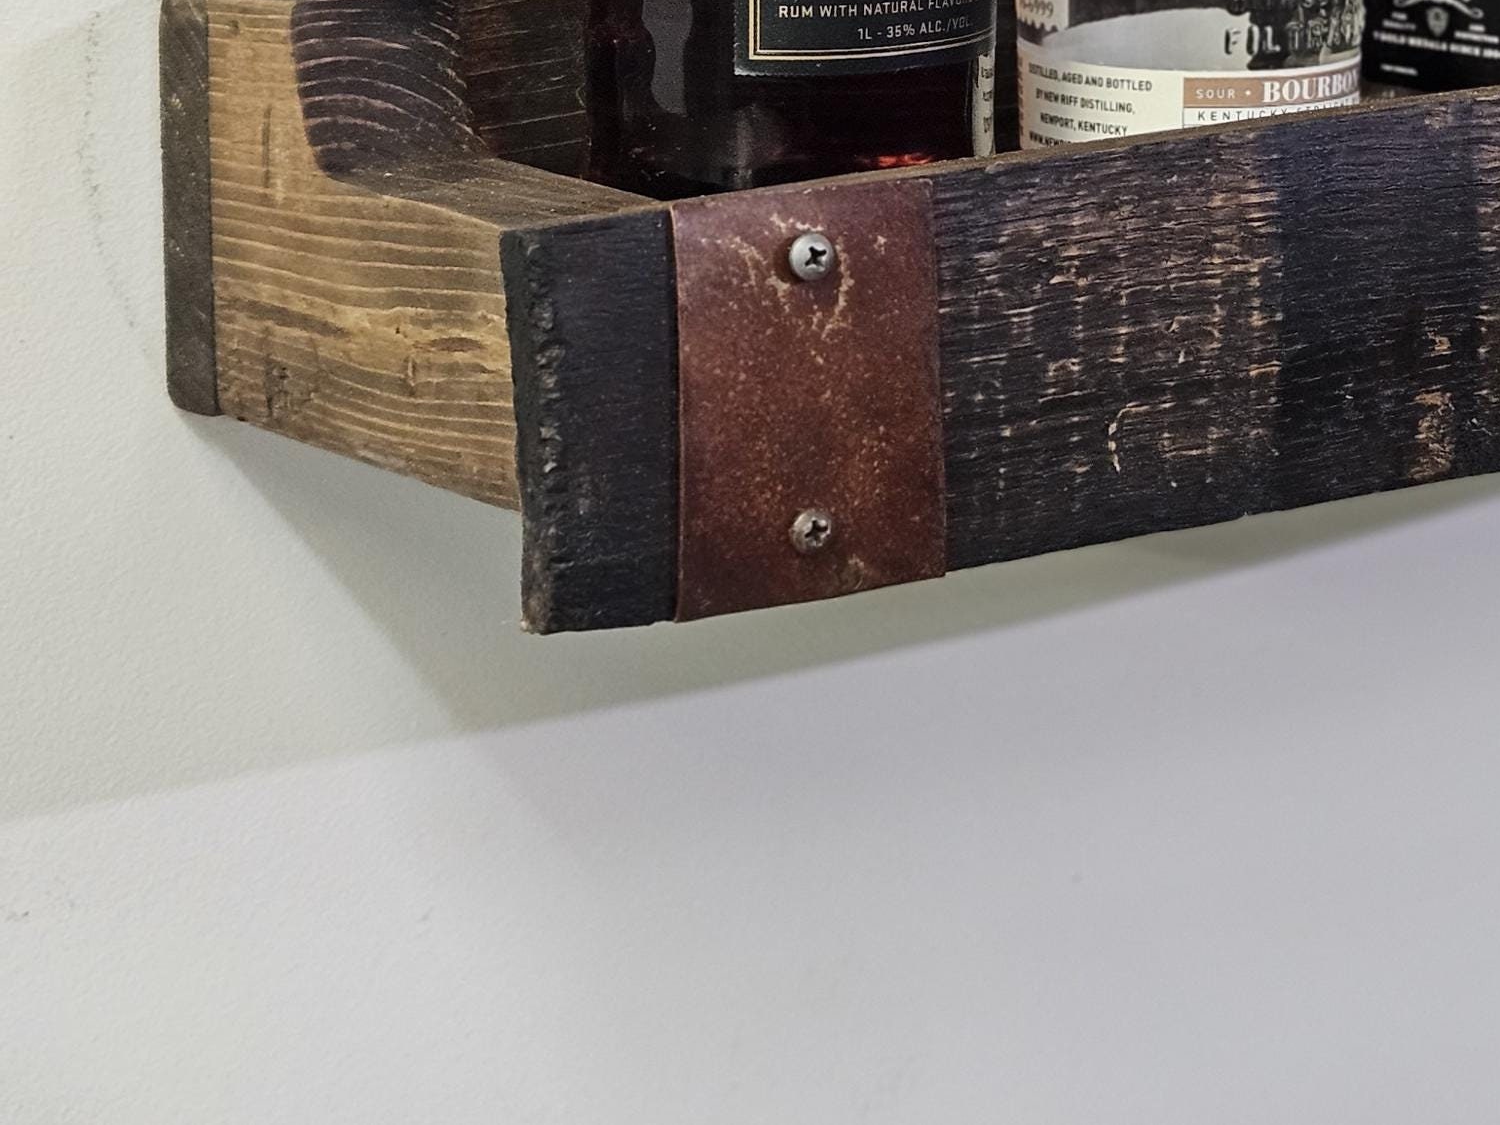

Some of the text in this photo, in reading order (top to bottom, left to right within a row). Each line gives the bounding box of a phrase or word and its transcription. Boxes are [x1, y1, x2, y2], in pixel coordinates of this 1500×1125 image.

[778, 4, 814, 19] RUM
[819, 3, 858, 19] WITH
[863, 0, 924, 16] NATURAL
[886, 22, 916, 38] 35%
[1061, 71, 1084, 85] AGED
[1084, 74, 1103, 87] AND
[1106, 76, 1153, 92] BOTTLED
[1043, 90, 1060, 104] NEW
[1060, 93, 1079, 107] RIFF
[1080, 97, 1136, 115] DISTILLING,
[1195, 87, 1237, 100] SOUR
[1078, 120, 1128, 137] KENTUCKY
